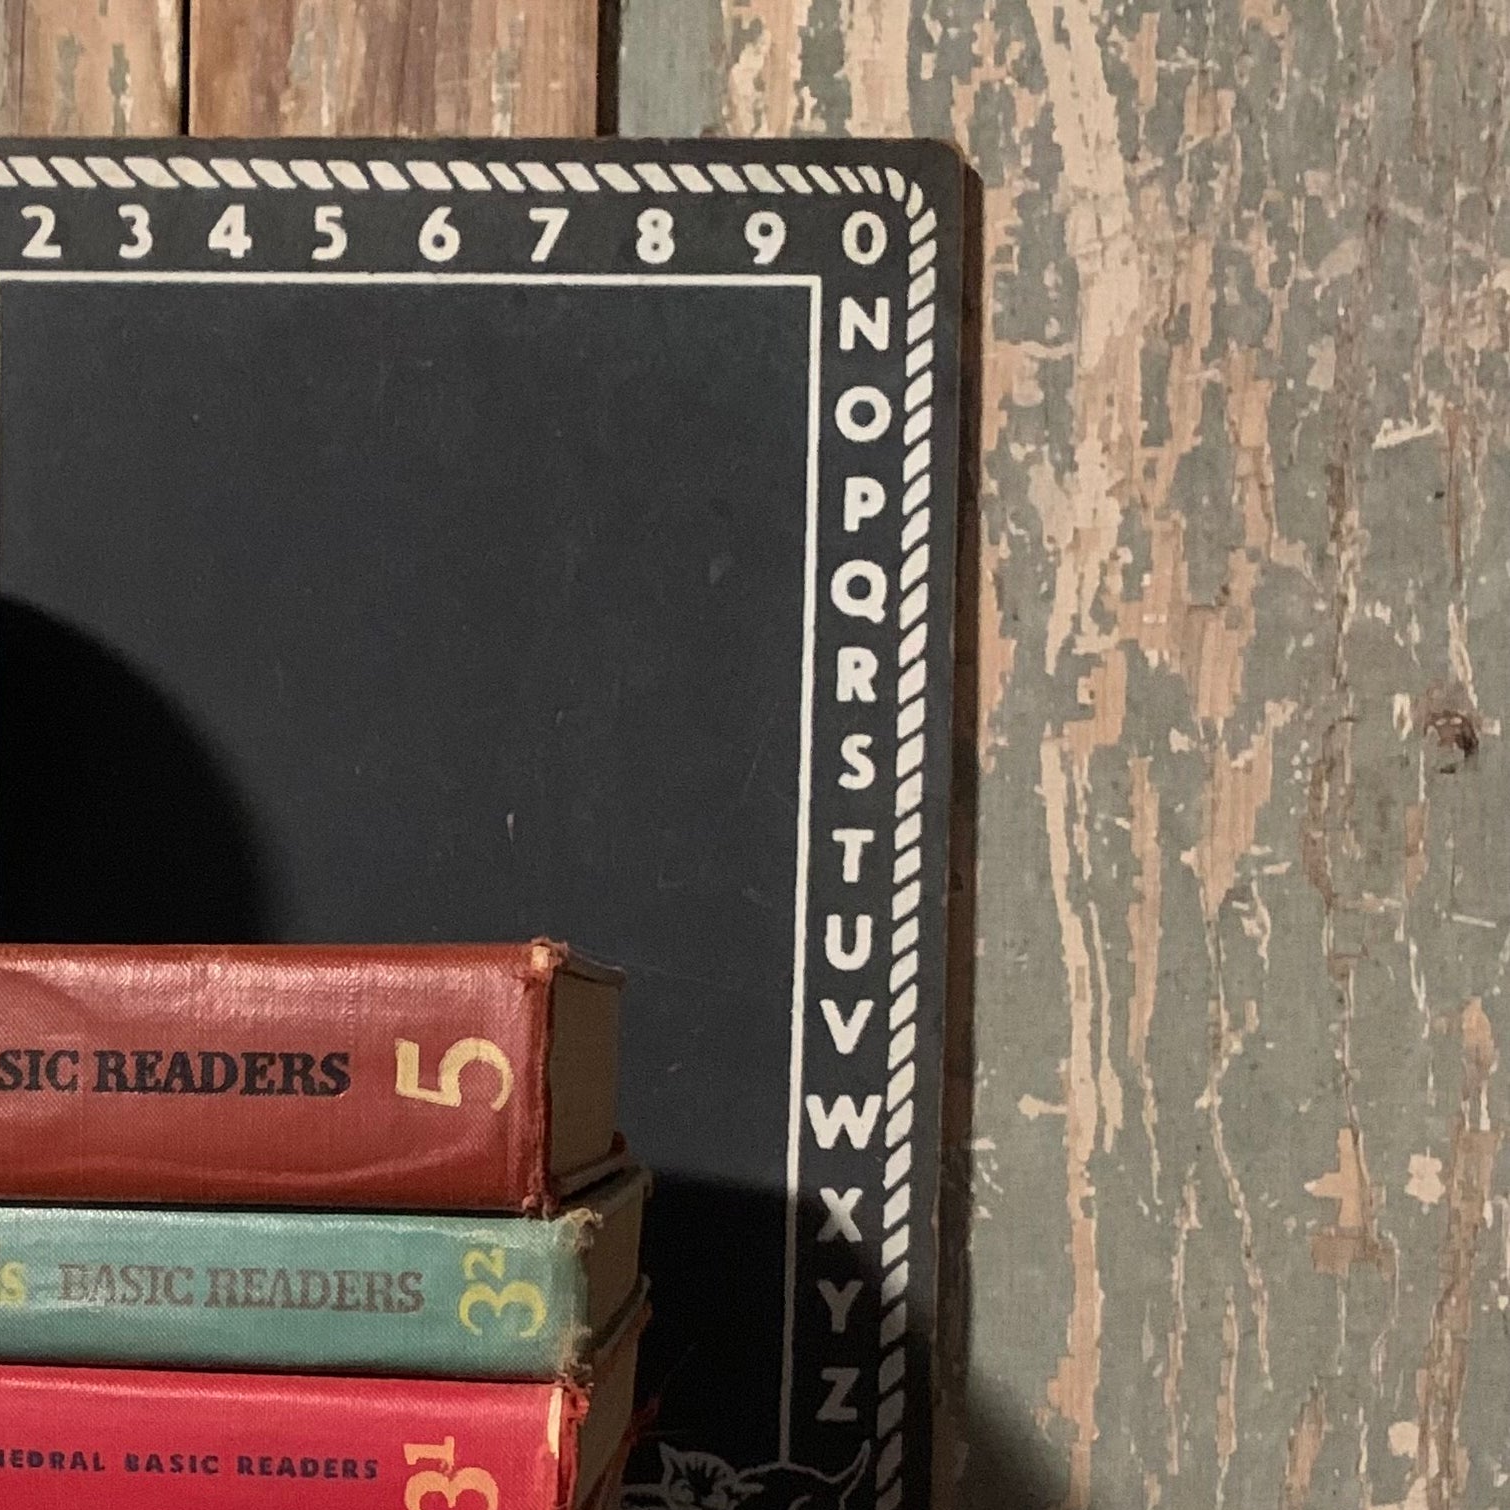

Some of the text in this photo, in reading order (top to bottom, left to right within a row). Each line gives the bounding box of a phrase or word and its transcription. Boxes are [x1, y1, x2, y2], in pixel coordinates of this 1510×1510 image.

[21, 204, 62, 259] 2
[118, 204, 153, 259] 3
[208, 204, 252, 259] 4
[312, 205, 347, 261] 5
[418, 206, 461, 262] 6
[529, 207, 569, 262] 7
[635, 208, 675, 264] 8
[744, 210, 786, 265] 9
[841, 210, 887, 265] 0
[805, 297, 891, 1421] N O P Q R S T U V W X Y Z
[92, 1049, 352, 1098] READERS
[395, 1037, 515, 1113] 5
[57, 1262, 194, 1306] BASIC
[205, 1267, 425, 1314] READERS
[124, 1452, 220, 1476] BASIC
[237, 1455, 379, 1481] READERS
